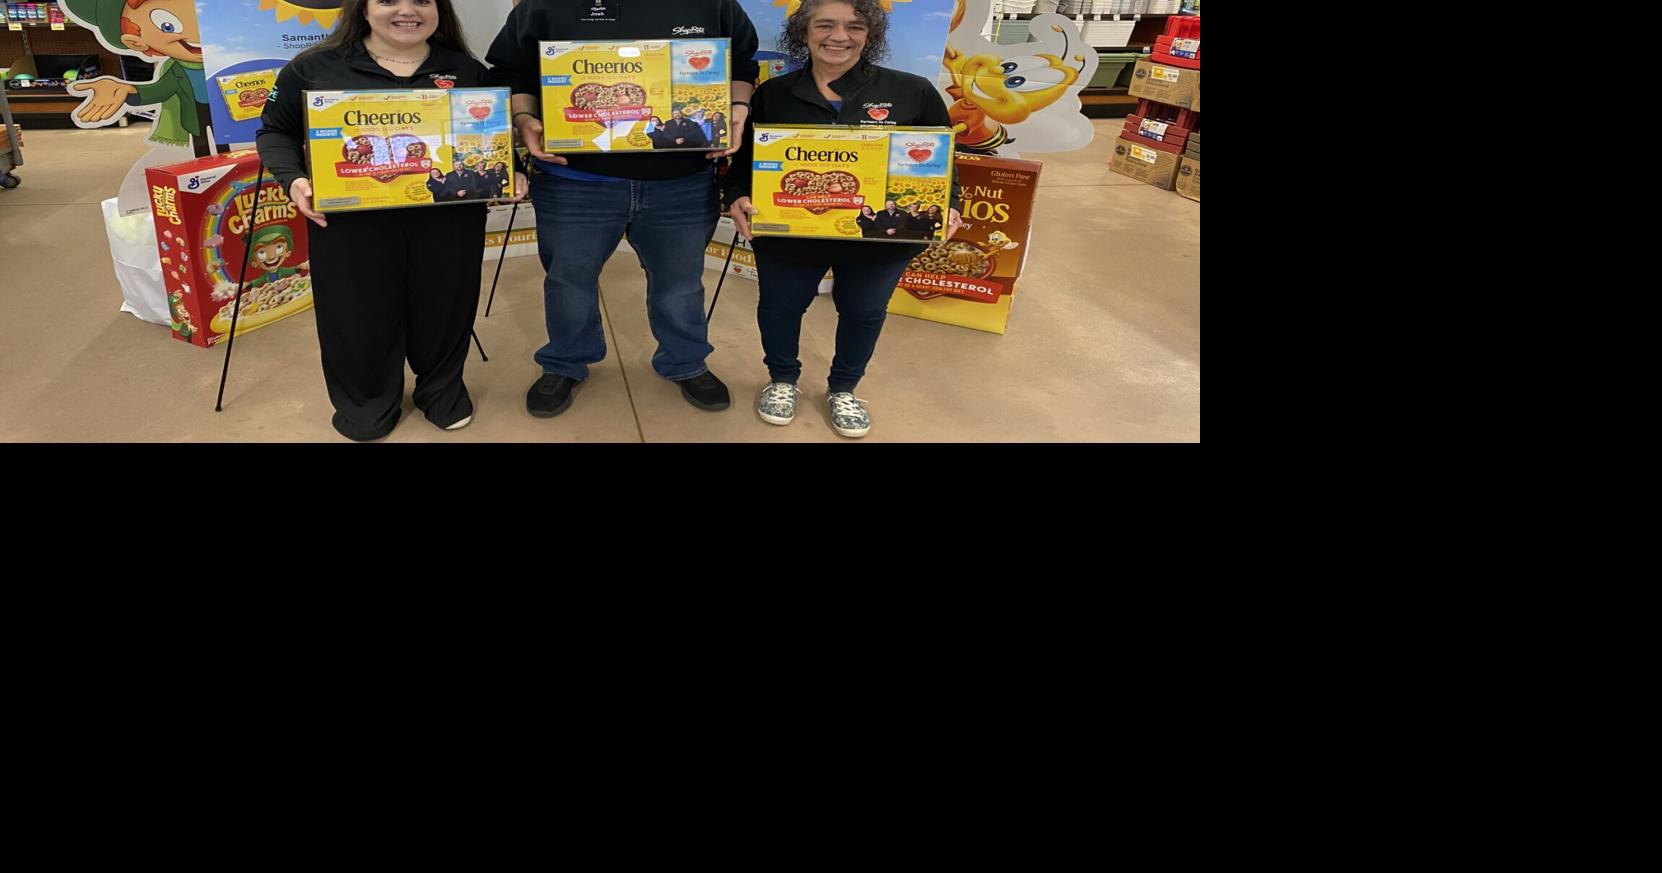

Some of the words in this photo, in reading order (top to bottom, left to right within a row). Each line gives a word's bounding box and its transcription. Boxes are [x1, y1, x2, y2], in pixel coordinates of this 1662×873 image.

[572, 60, 643, 74] Cheerios
[236, 79, 266, 88] Cheerios
[344, 110, 421, 126] Cheerios
[594, 110, 640, 118] CHOLESTEROL
[785, 146, 858, 162] Cheerios
[368, 162, 418, 172] CHOLESTEROL
[991, 170, 1014, 179] Gluten
[974, 186, 1004, 200] Nut
[153, 186, 164, 218] Lucky
[163, 186, 182, 225] Charms
[234, 186, 289, 217] Lucky
[228, 202, 298, 235] Charms
[959, 198, 1010, 223] ios
[498, 232, 536, 244] Fouri
[905, 277, 994, 295] CHOLESTEROL
